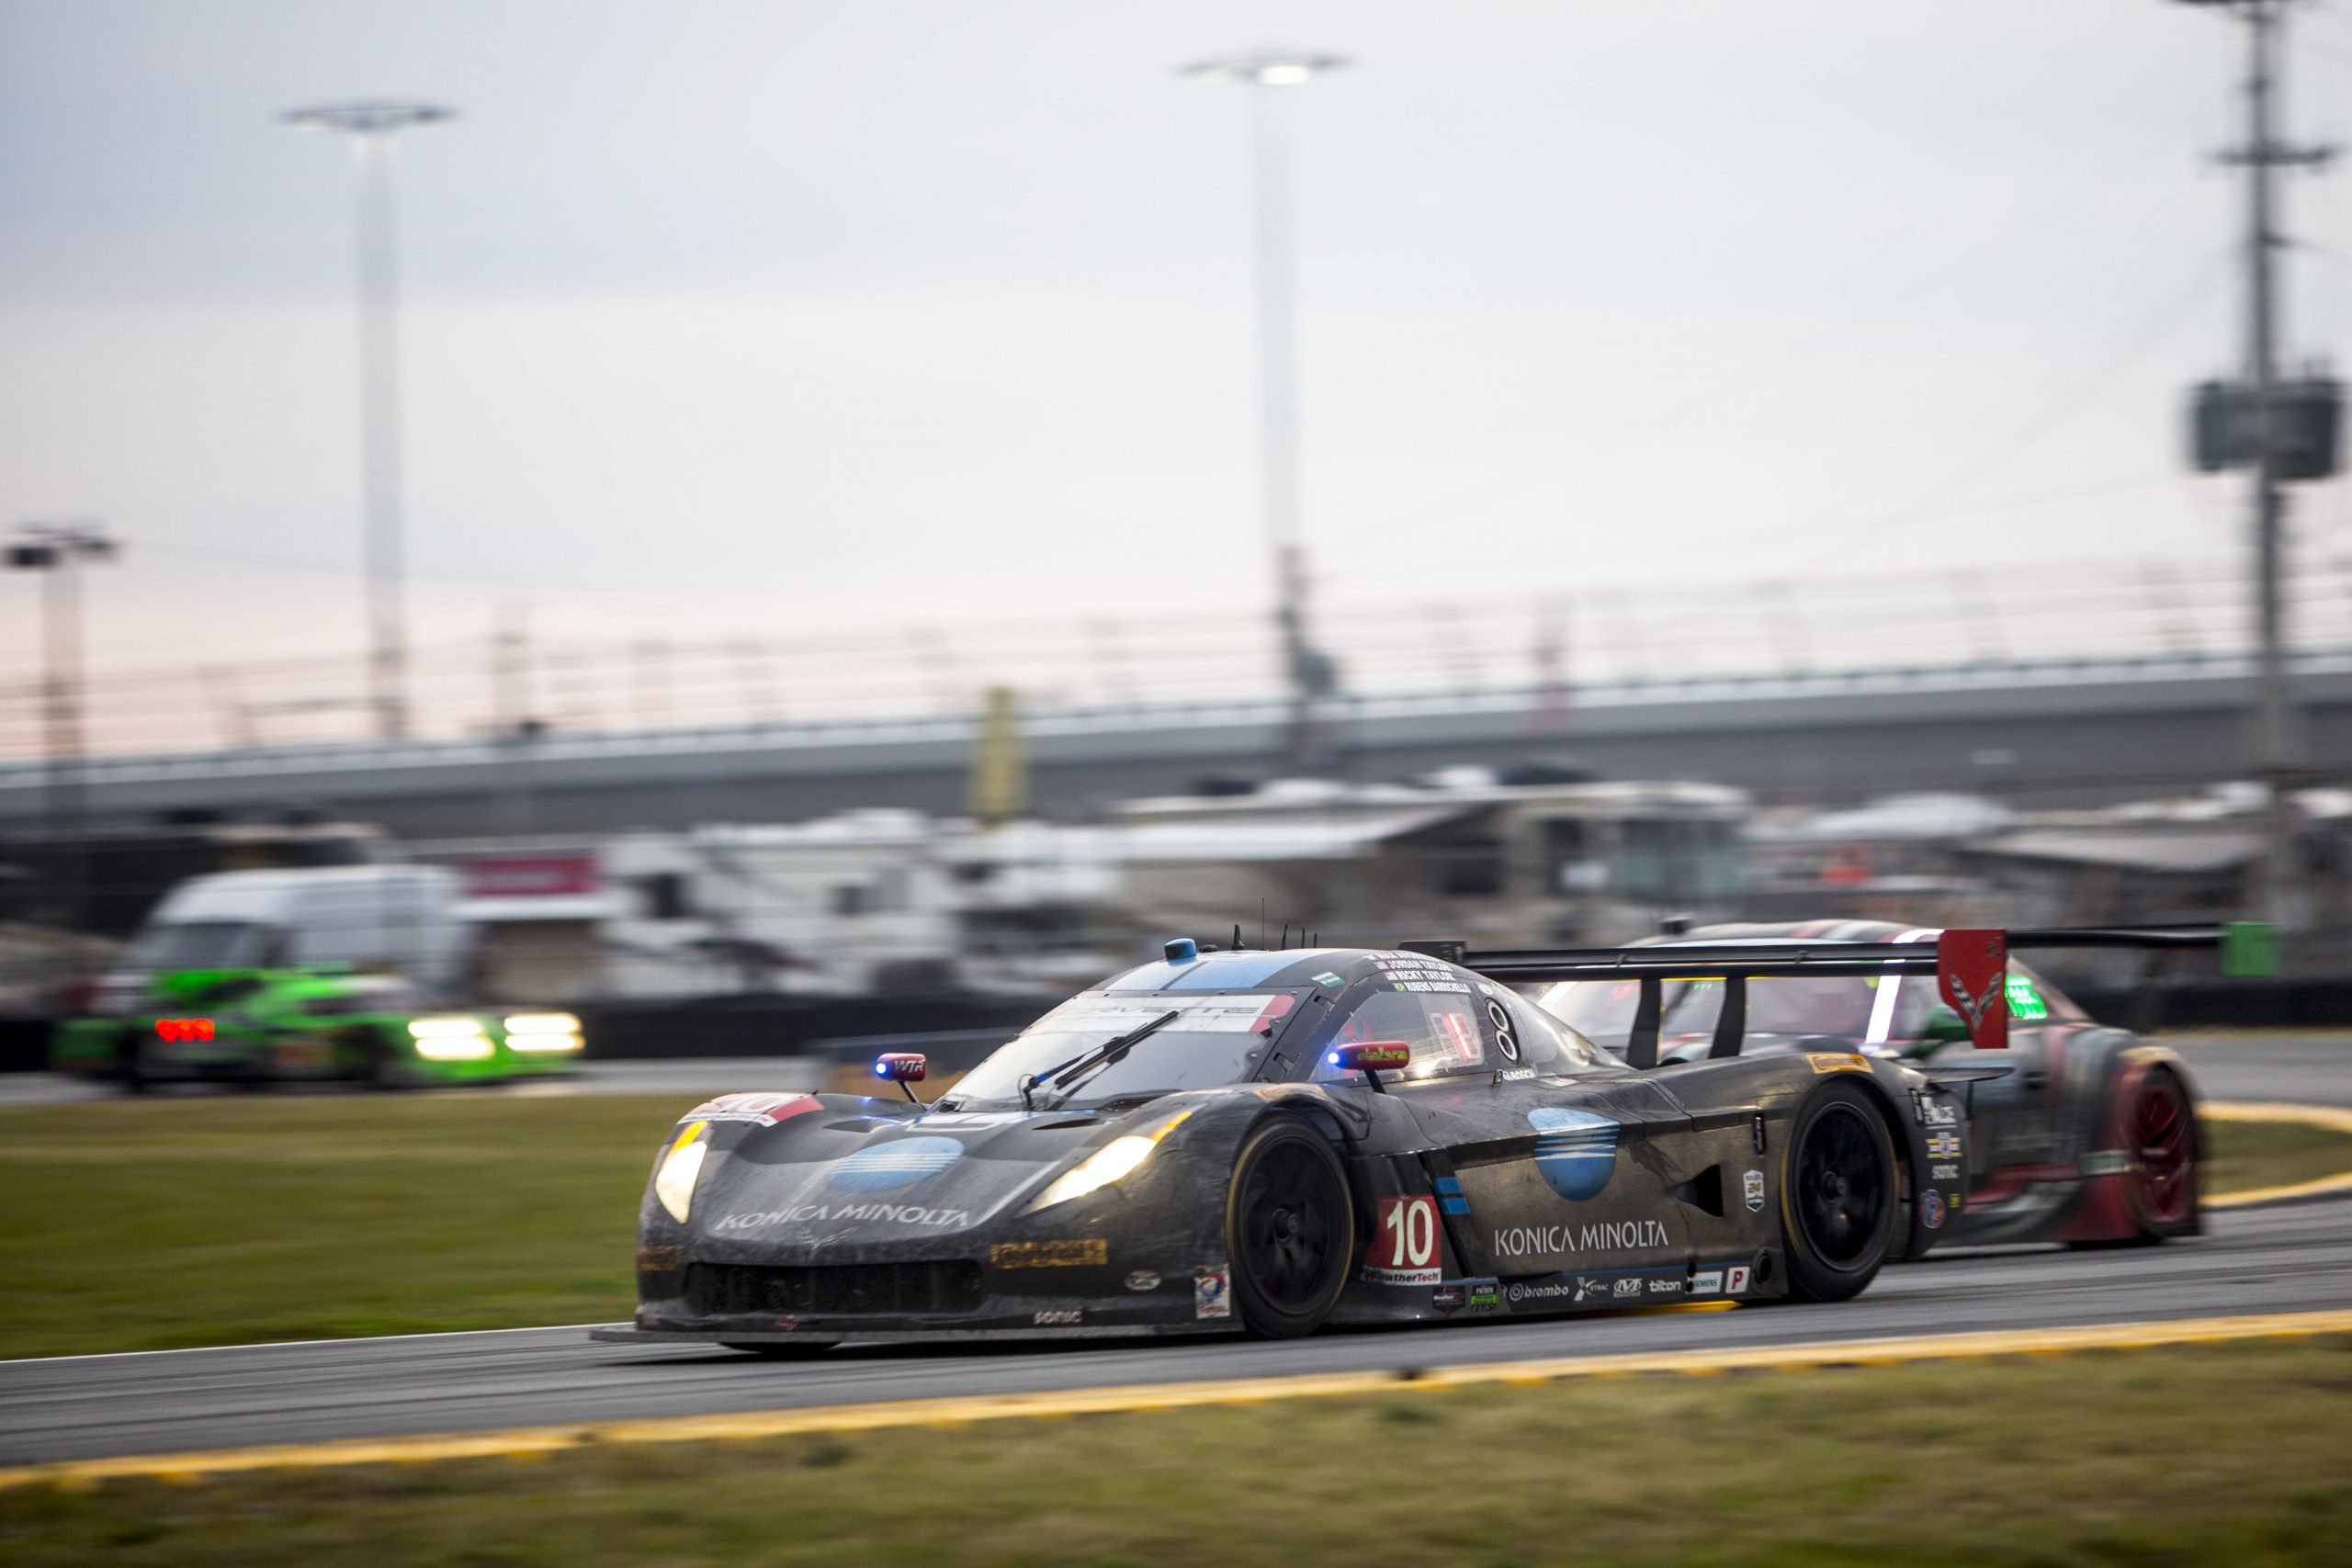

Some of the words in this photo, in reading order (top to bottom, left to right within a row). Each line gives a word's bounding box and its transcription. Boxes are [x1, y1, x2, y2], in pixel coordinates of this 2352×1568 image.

[1387, 960, 1422, 970] JORDAN
[1419, 961, 1453, 972] TAYLOR
[1396, 970, 1424, 981] RICKY
[1421, 970, 1455, 982] TAYLOR
[1403, 982, 1431, 993] RUBENS
[894, 1060, 925, 1073] WTR
[1510, 1069, 1538, 1079] BOSCH
[715, 1205, 828, 1231] KONICA
[829, 1203, 968, 1227] MINOLTA
[1386, 1200, 1433, 1267] 10
[1494, 1225, 1576, 1257] KONICA
[1580, 1220, 1669, 1251] MINOLTA
[1648, 1280, 1681, 1292] tilton
[1731, 1269, 1744, 1291] P
[1523, 1284, 1569, 1298] brembo
